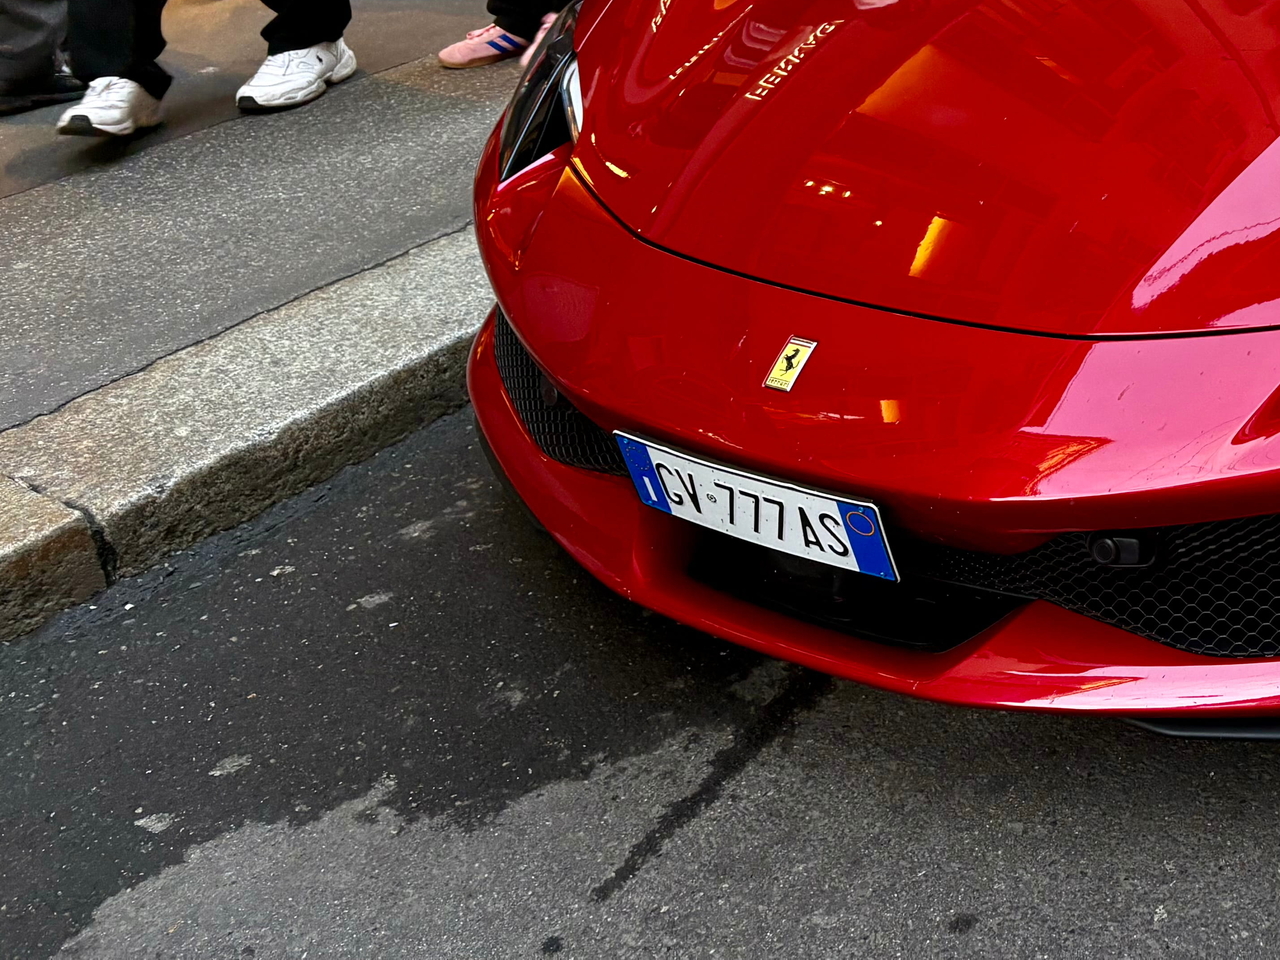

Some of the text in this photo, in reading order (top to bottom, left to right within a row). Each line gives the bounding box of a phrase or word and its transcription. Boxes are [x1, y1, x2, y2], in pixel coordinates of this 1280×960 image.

[654, 462, 703, 514] GV
[713, 481, 786, 541] 777
[798, 506, 850, 557] AS
